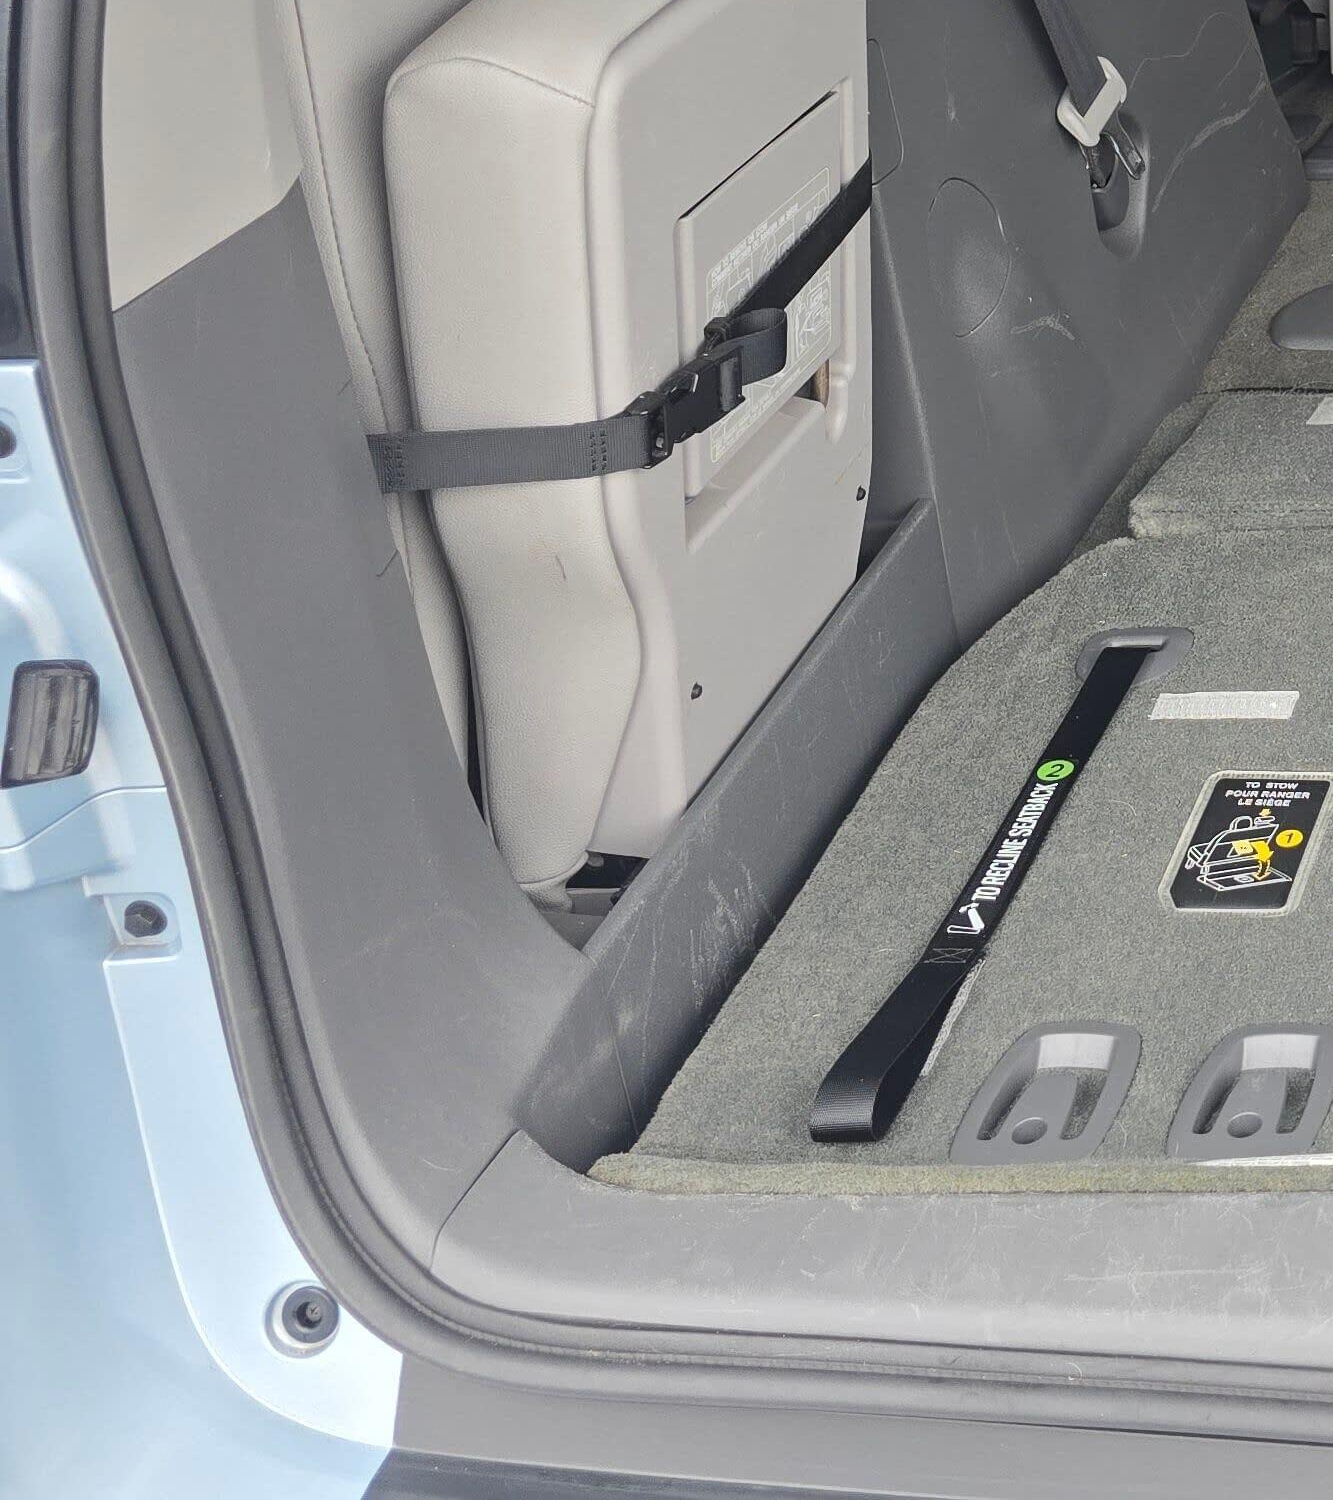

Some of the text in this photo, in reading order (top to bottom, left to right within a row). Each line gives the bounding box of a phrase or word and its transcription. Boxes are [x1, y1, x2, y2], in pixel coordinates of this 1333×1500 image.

[1046, 763, 1065, 778] 2
[1225, 790, 1311, 799] POUR RANGER
[1238, 798, 1253, 806] LE
[971, 782, 1059, 901] TO RECLINE SEATBACK
